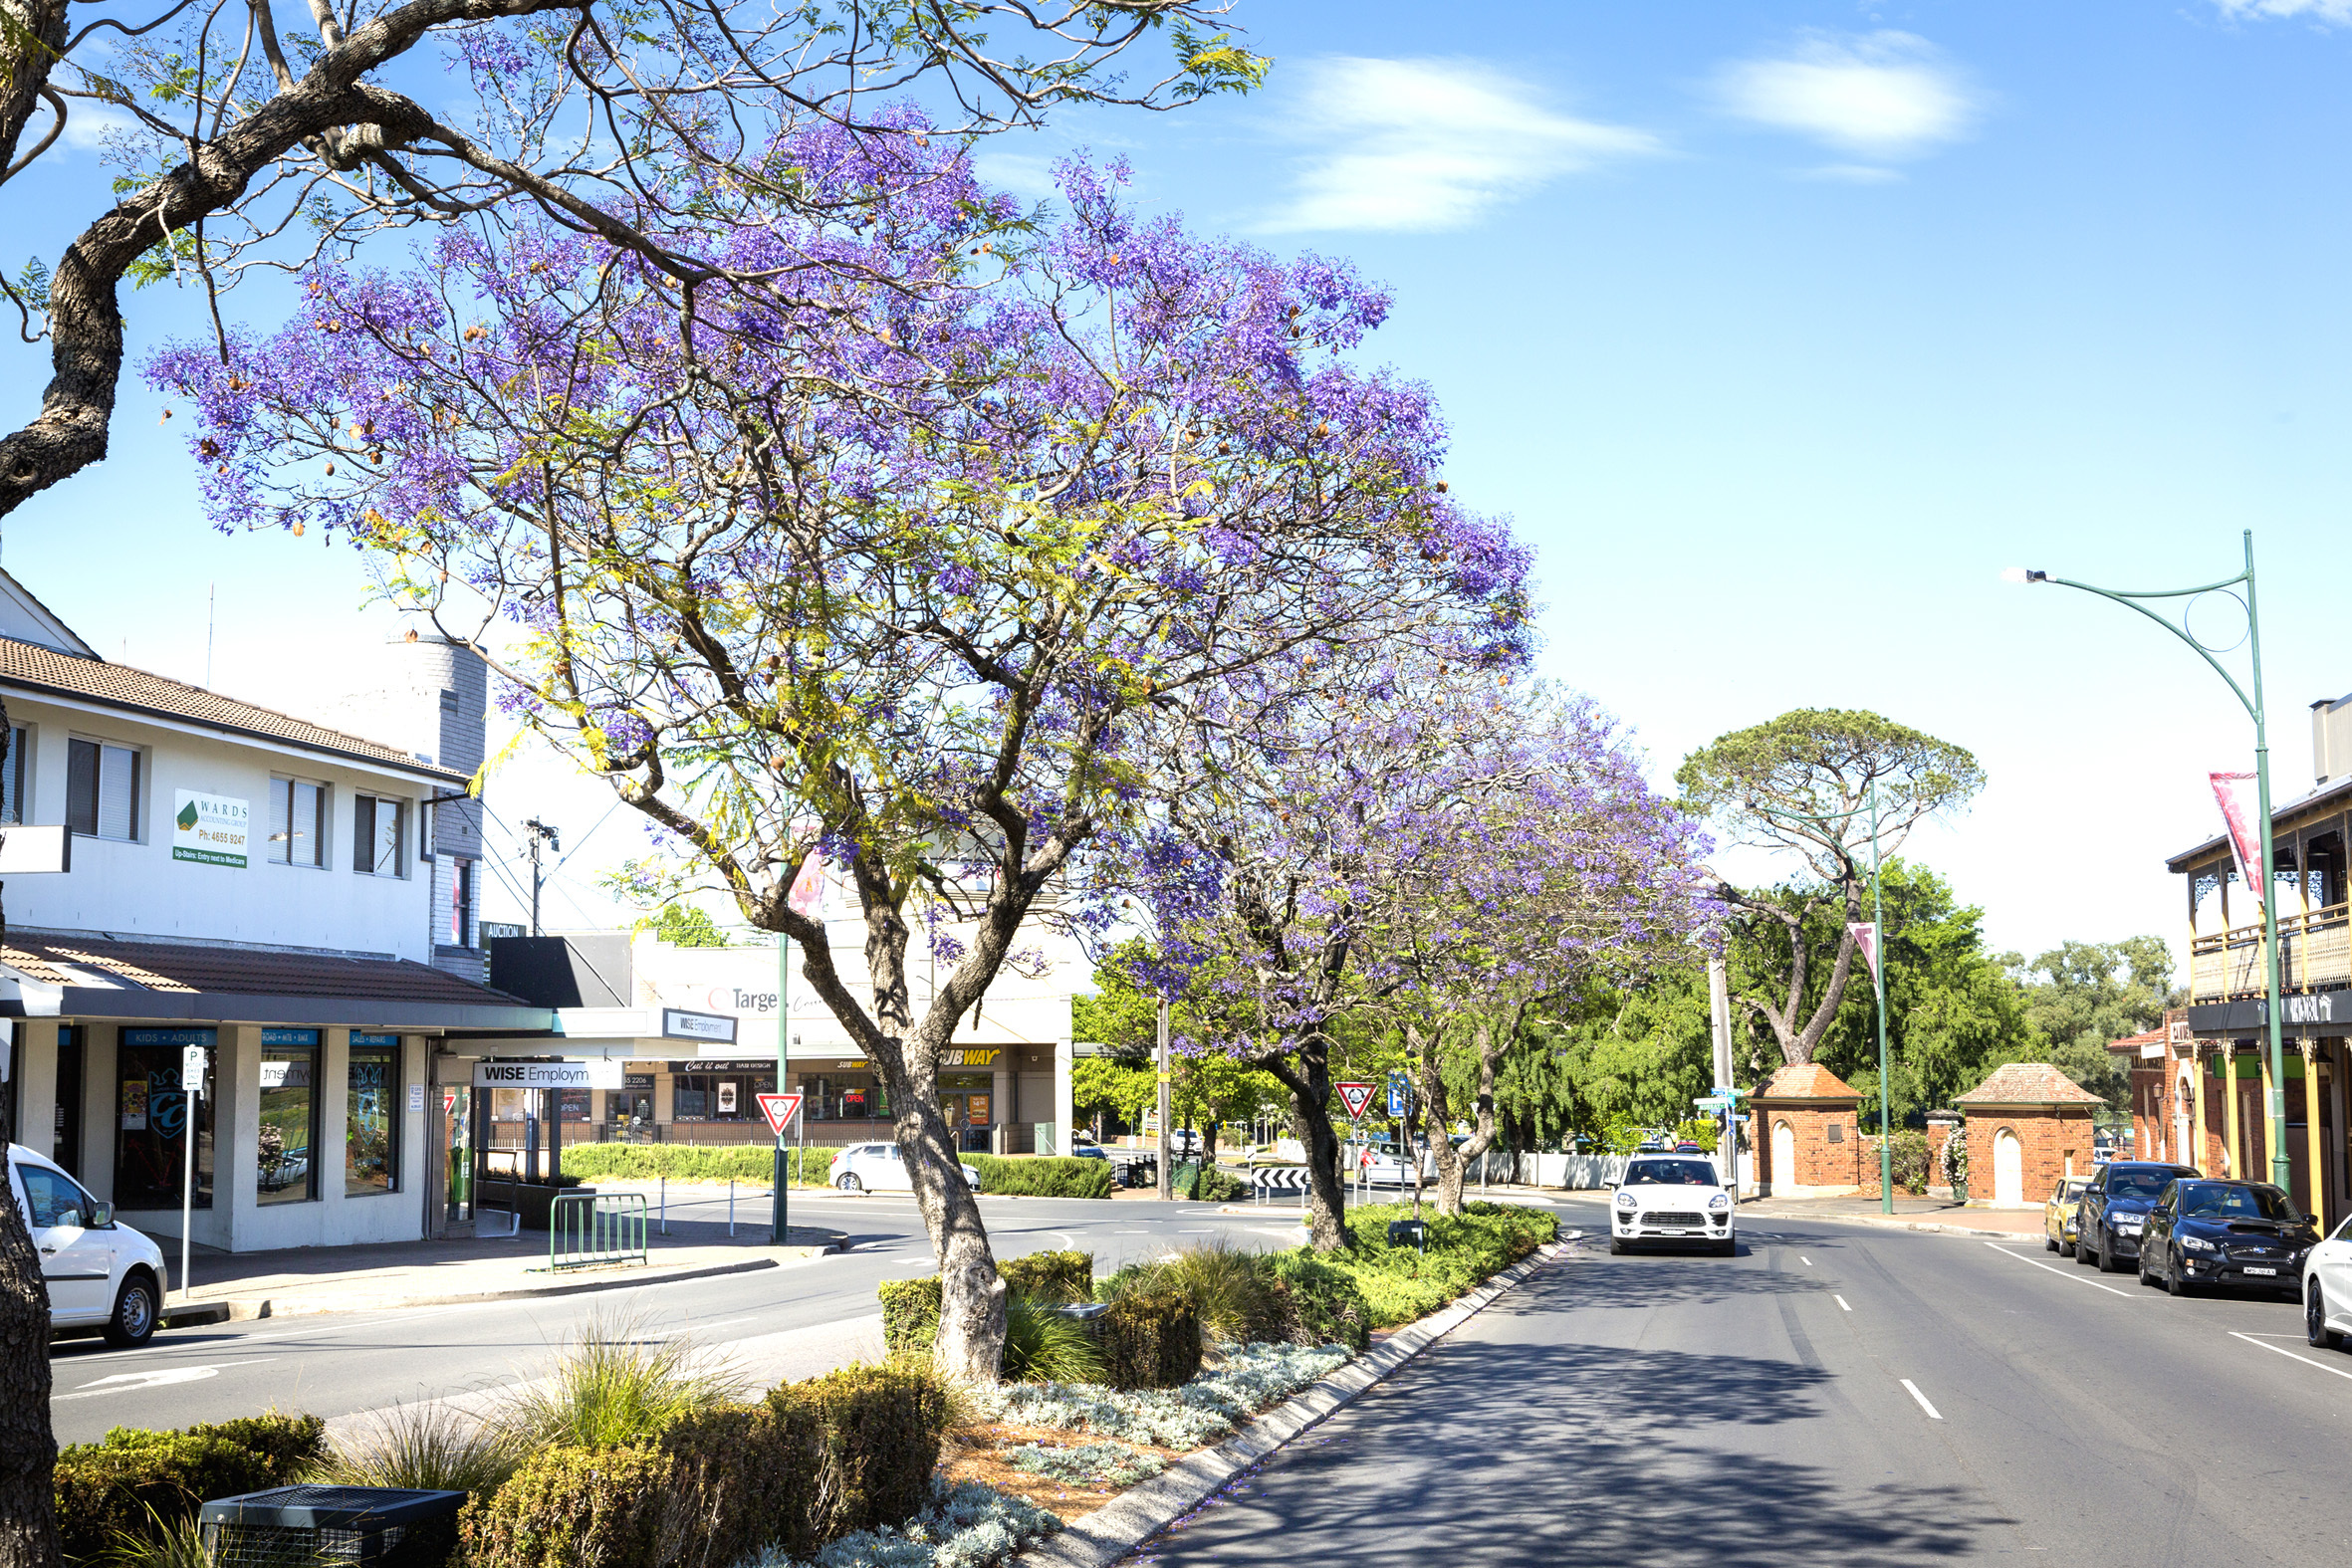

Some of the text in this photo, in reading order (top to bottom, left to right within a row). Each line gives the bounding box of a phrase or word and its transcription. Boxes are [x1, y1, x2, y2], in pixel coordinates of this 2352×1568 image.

[201, 800, 247, 818] WARDS
[200, 815, 247, 828] ACCOUNTING GROUP
[199, 829, 245, 845] Ph: 4655 9247
[198, 852, 210, 862] Entry
[225, 856, 245, 865] Medicare
[488, 923, 518, 938] AUCTION
[733, 988, 789, 1011] Targe
[680, 1016, 722, 1034] WISE Employment
[135, 1033, 207, 1042] KIDS ADULTS
[190, 1050, 198, 1061] P
[685, 1060, 703, 1072] Cut
[705, 1061, 714, 1070] it
[715, 1061, 730, 1070] out
[485, 1066, 589, 1083] WISE Employm
